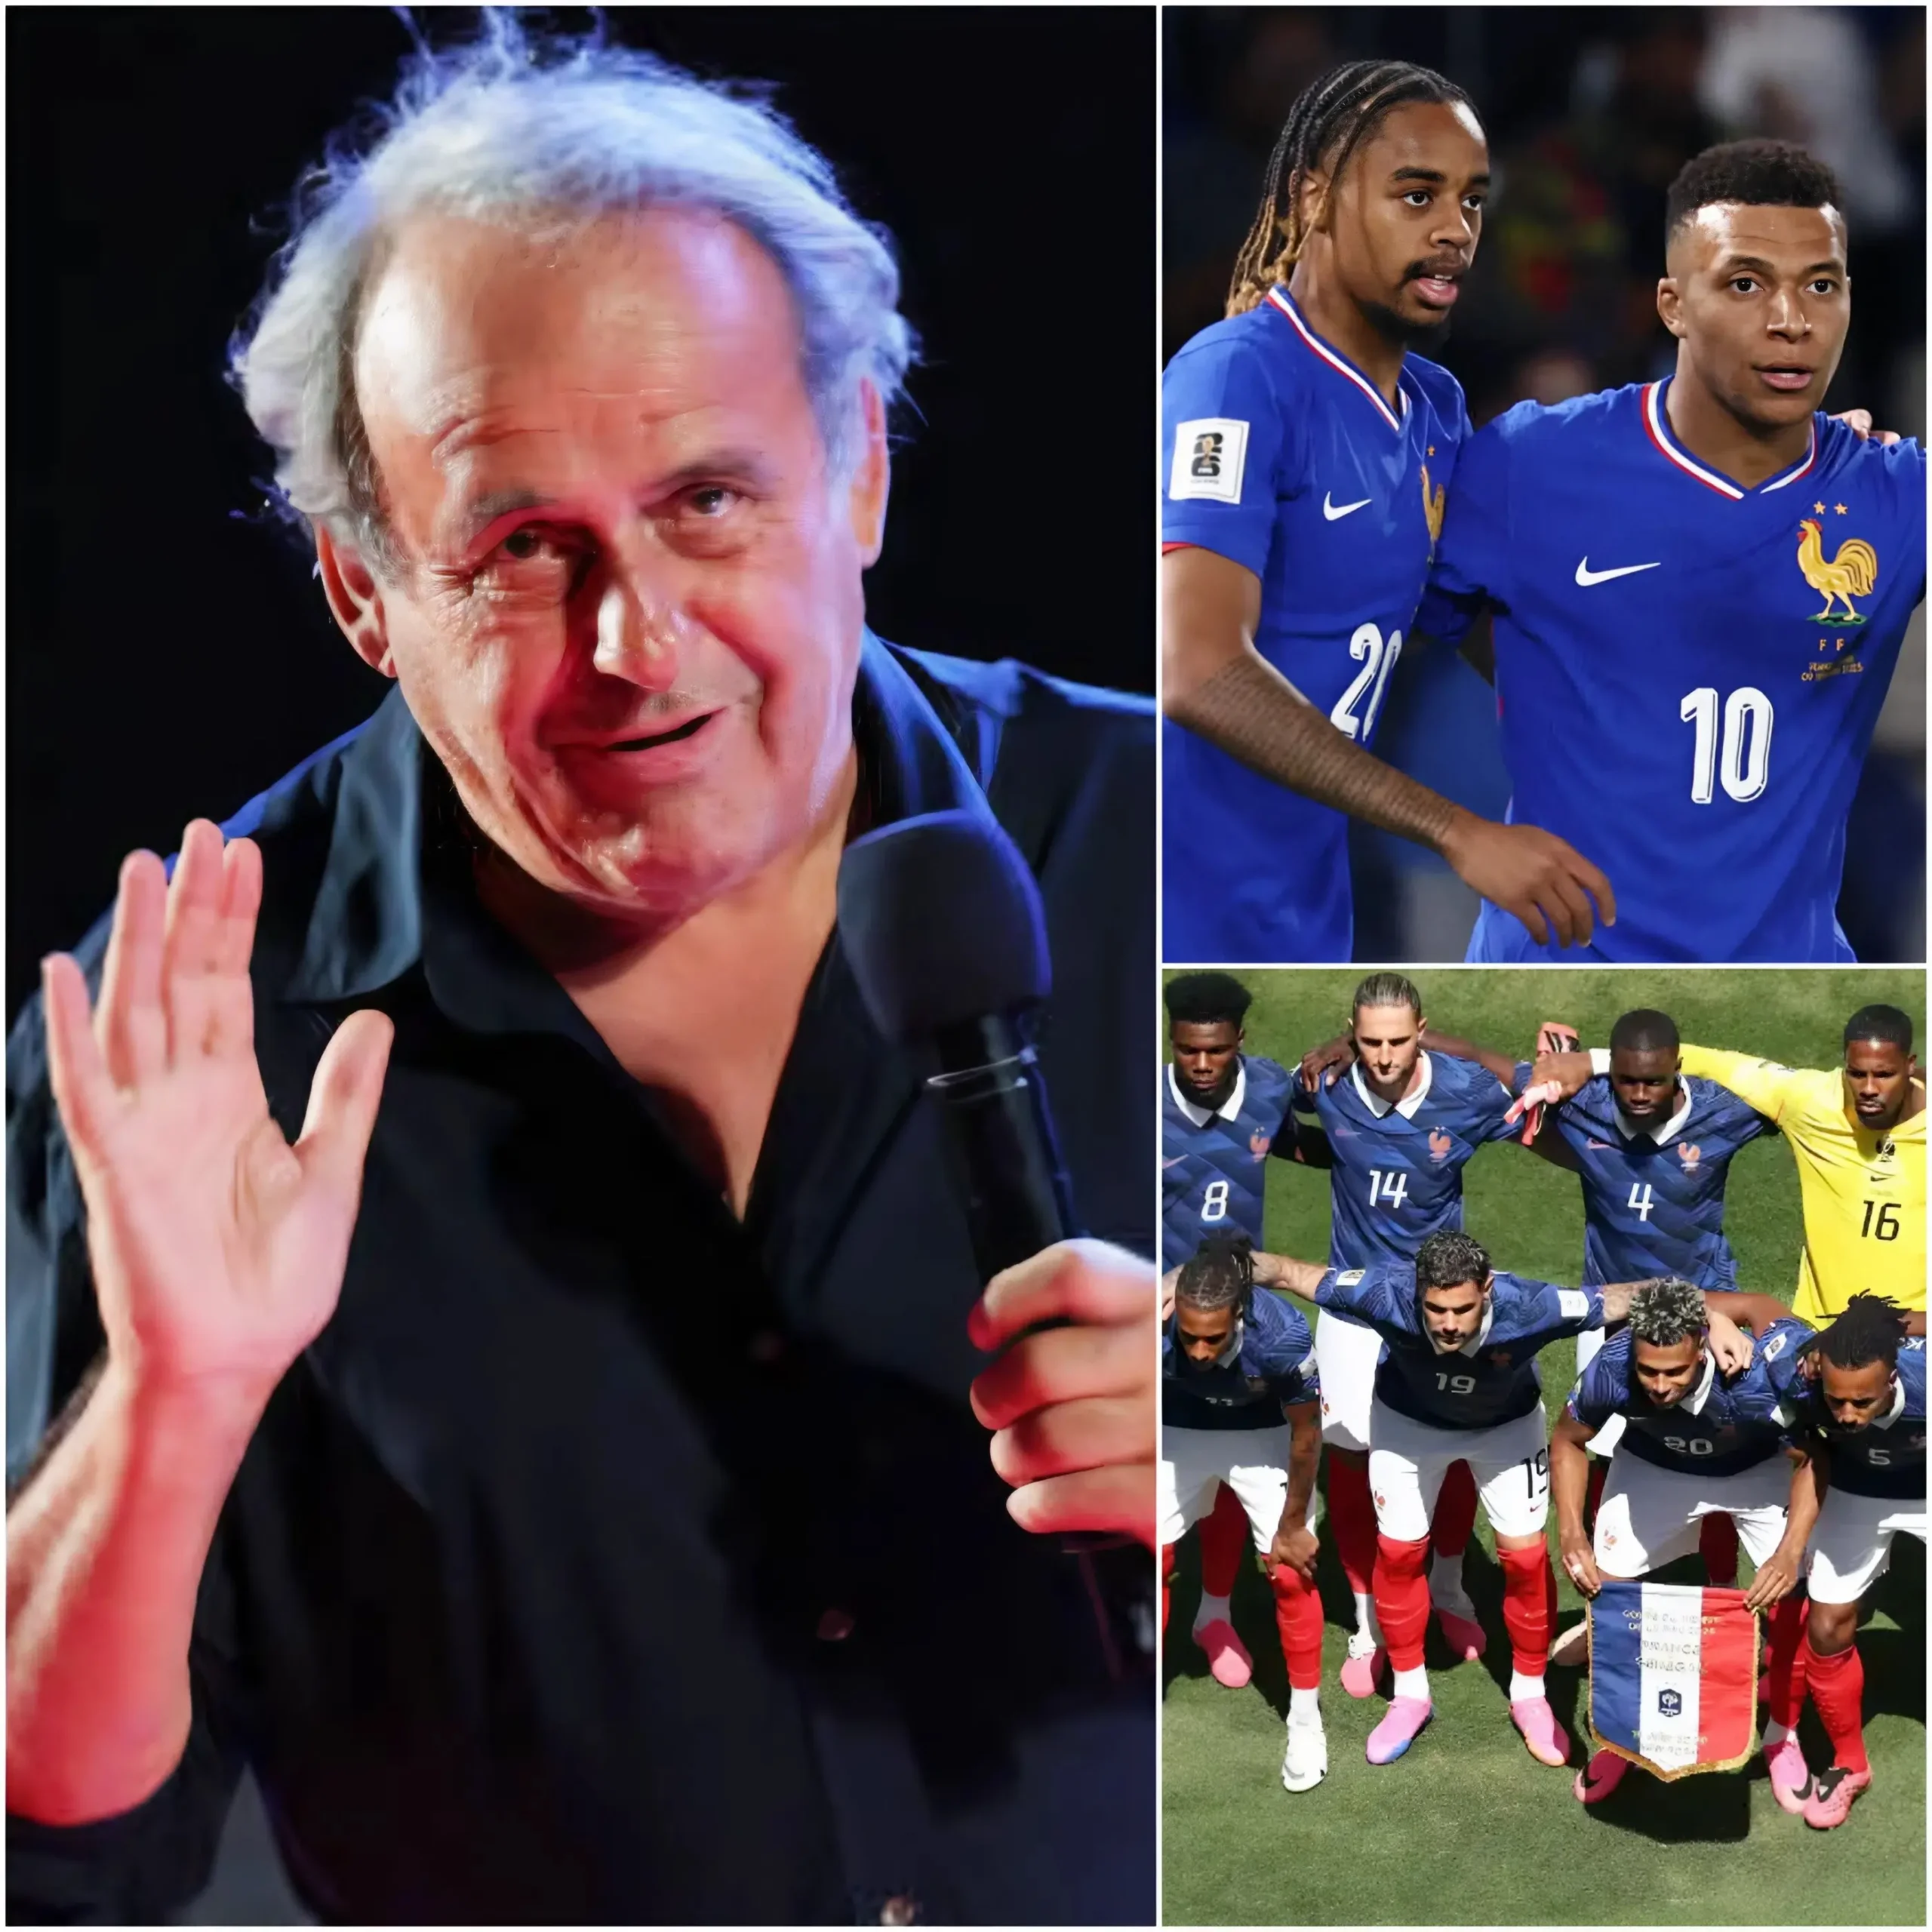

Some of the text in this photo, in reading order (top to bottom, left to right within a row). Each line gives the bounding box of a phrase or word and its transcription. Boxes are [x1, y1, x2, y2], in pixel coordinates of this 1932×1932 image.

[1680, 686, 1774, 804] 10
[1201, 1180, 1229, 1222] 8
[1369, 1169, 1408, 1209] 14
[1627, 1183, 1654, 1222] 4
[1861, 1199, 1902, 1241] 16
[1435, 1372, 1477, 1394] 19
[1663, 1435, 1714, 1456] 20
[1868, 1447, 1890, 1465] 5
